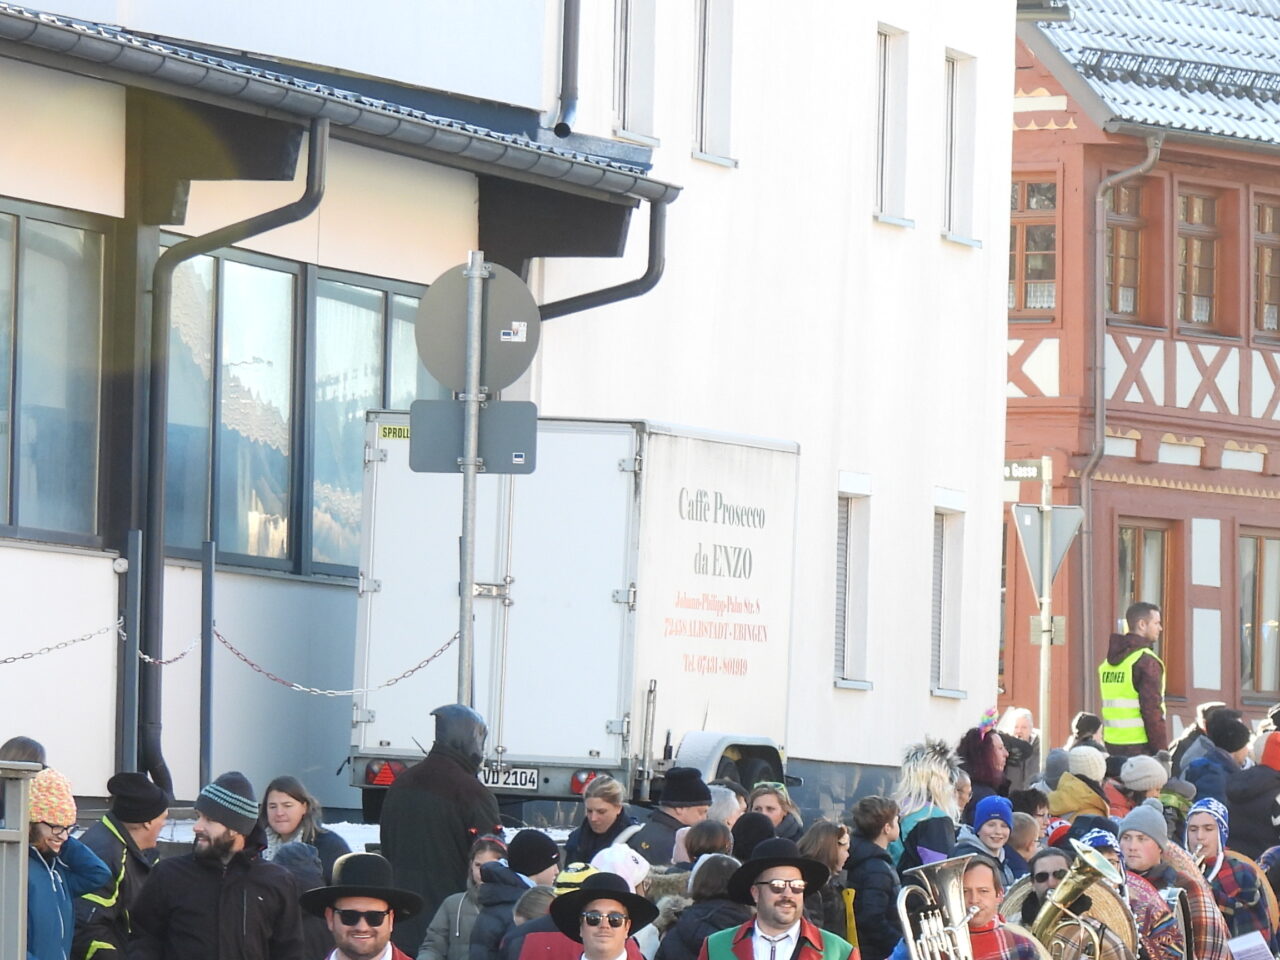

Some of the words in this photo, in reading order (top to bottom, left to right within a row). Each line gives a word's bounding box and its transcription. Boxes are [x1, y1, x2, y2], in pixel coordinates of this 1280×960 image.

[713, 491, 765, 529] Prosecco
[694, 542, 708, 576] da
[712, 544, 753, 580] ENZO
[502, 770, 536, 787] 2104
